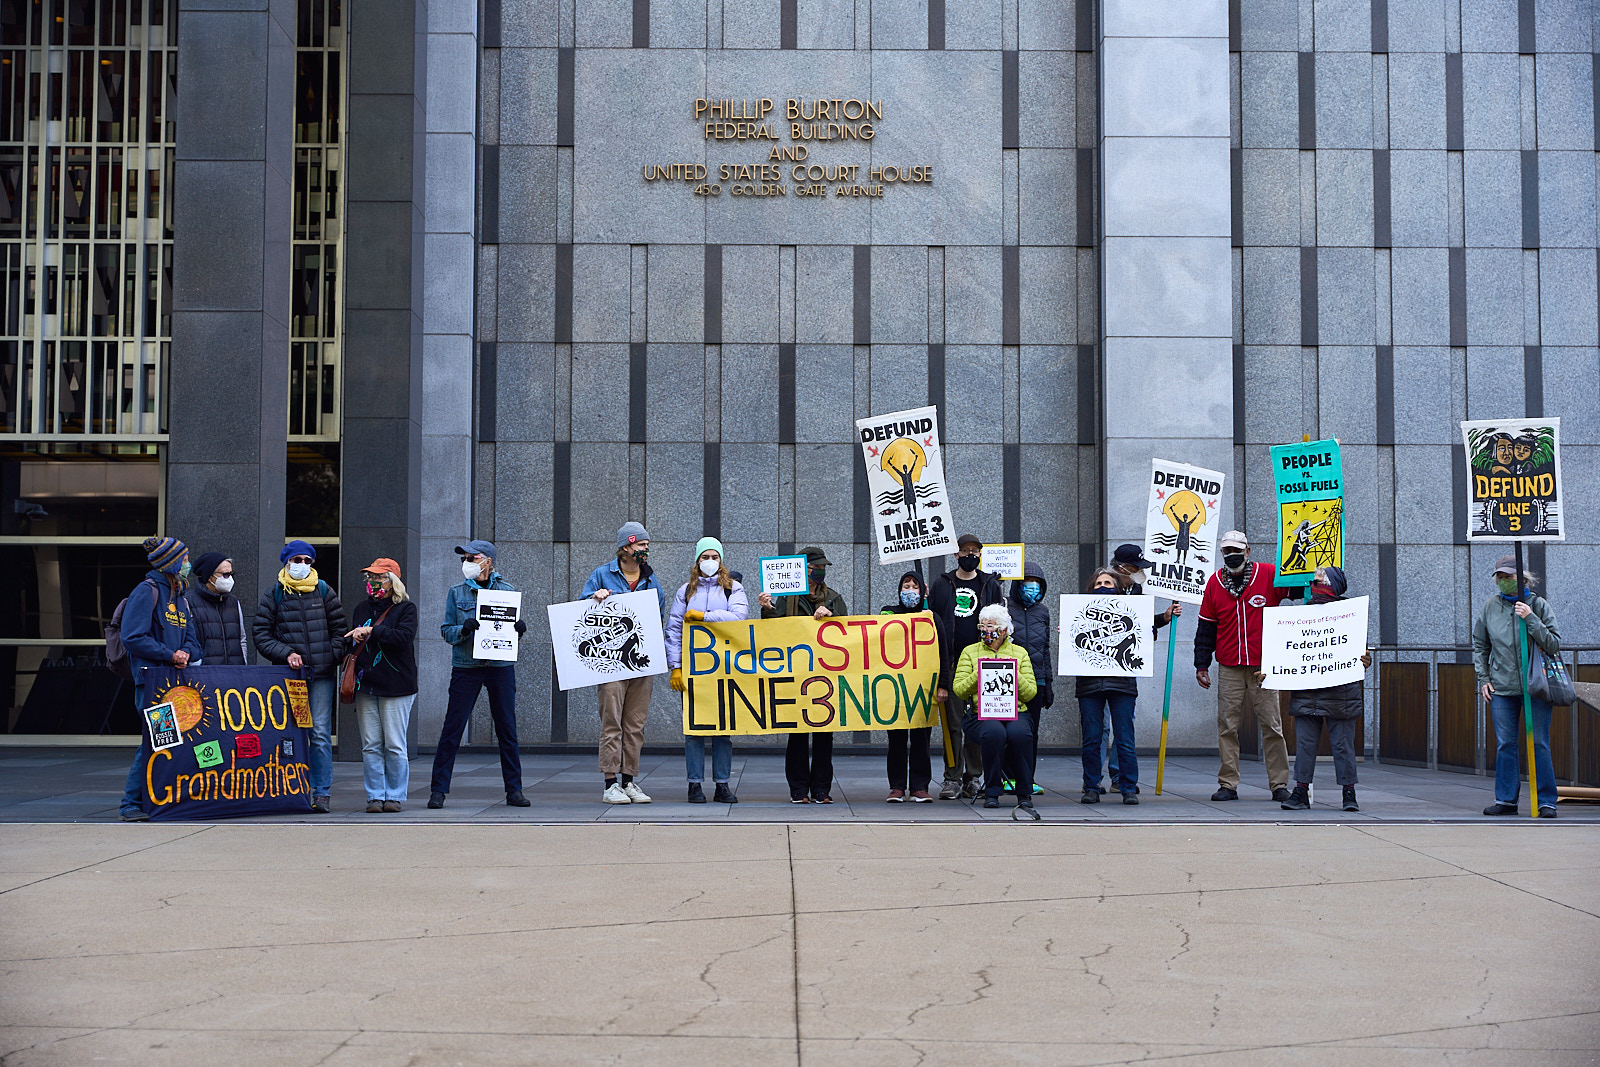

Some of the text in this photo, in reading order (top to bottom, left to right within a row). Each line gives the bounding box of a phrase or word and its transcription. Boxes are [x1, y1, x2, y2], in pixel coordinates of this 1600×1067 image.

[695, 98, 883, 120] PHILLIP BURTON
[705, 122, 875, 140] FEDERAL BUILDING
[768, 145, 808, 161] AND
[644, 164, 932, 182] UNITED STATES COURT HOUSE
[694, 184, 884, 197] 450 GOLDEN GATE AVENUE
[861, 418, 933, 443] DEFUND
[1281, 452, 1332, 470] PEOPLE
[1154, 471, 1221, 495] DEFUND
[1311, 479, 1339, 491] FUELS
[1475, 473, 1554, 499] DEFUND
[1499, 502, 1531, 516] LINE
[884, 515, 945, 542] LINE 3
[1509, 516, 1522, 531] 3
[883, 536, 950, 554] CLIMATE CRISIS
[766, 562, 785, 571] KEEP
[1151, 561, 1206, 585] LINE 3
[777, 572, 792, 580] THE
[769, 581, 801, 590] GROUND
[1147, 579, 1182, 592] CLIMATE
[585, 615, 620, 628] STOP
[1086, 608, 1120, 624] STOP
[1301, 627, 1335, 637] Why no
[689, 617, 936, 676] Biden STOP
[1286, 634, 1348, 650] Federal EIS
[1302, 652, 1334, 662] for the
[1272, 657, 1358, 675] Line 3 Pipeline?
[214, 684, 287, 732] 1000
[688, 672, 938, 731] LINE 3 NOW
[155, 730, 174, 740] FOSSIL
[157, 737, 174, 746] FREE
[146, 744, 310, 806] Grandmothers
